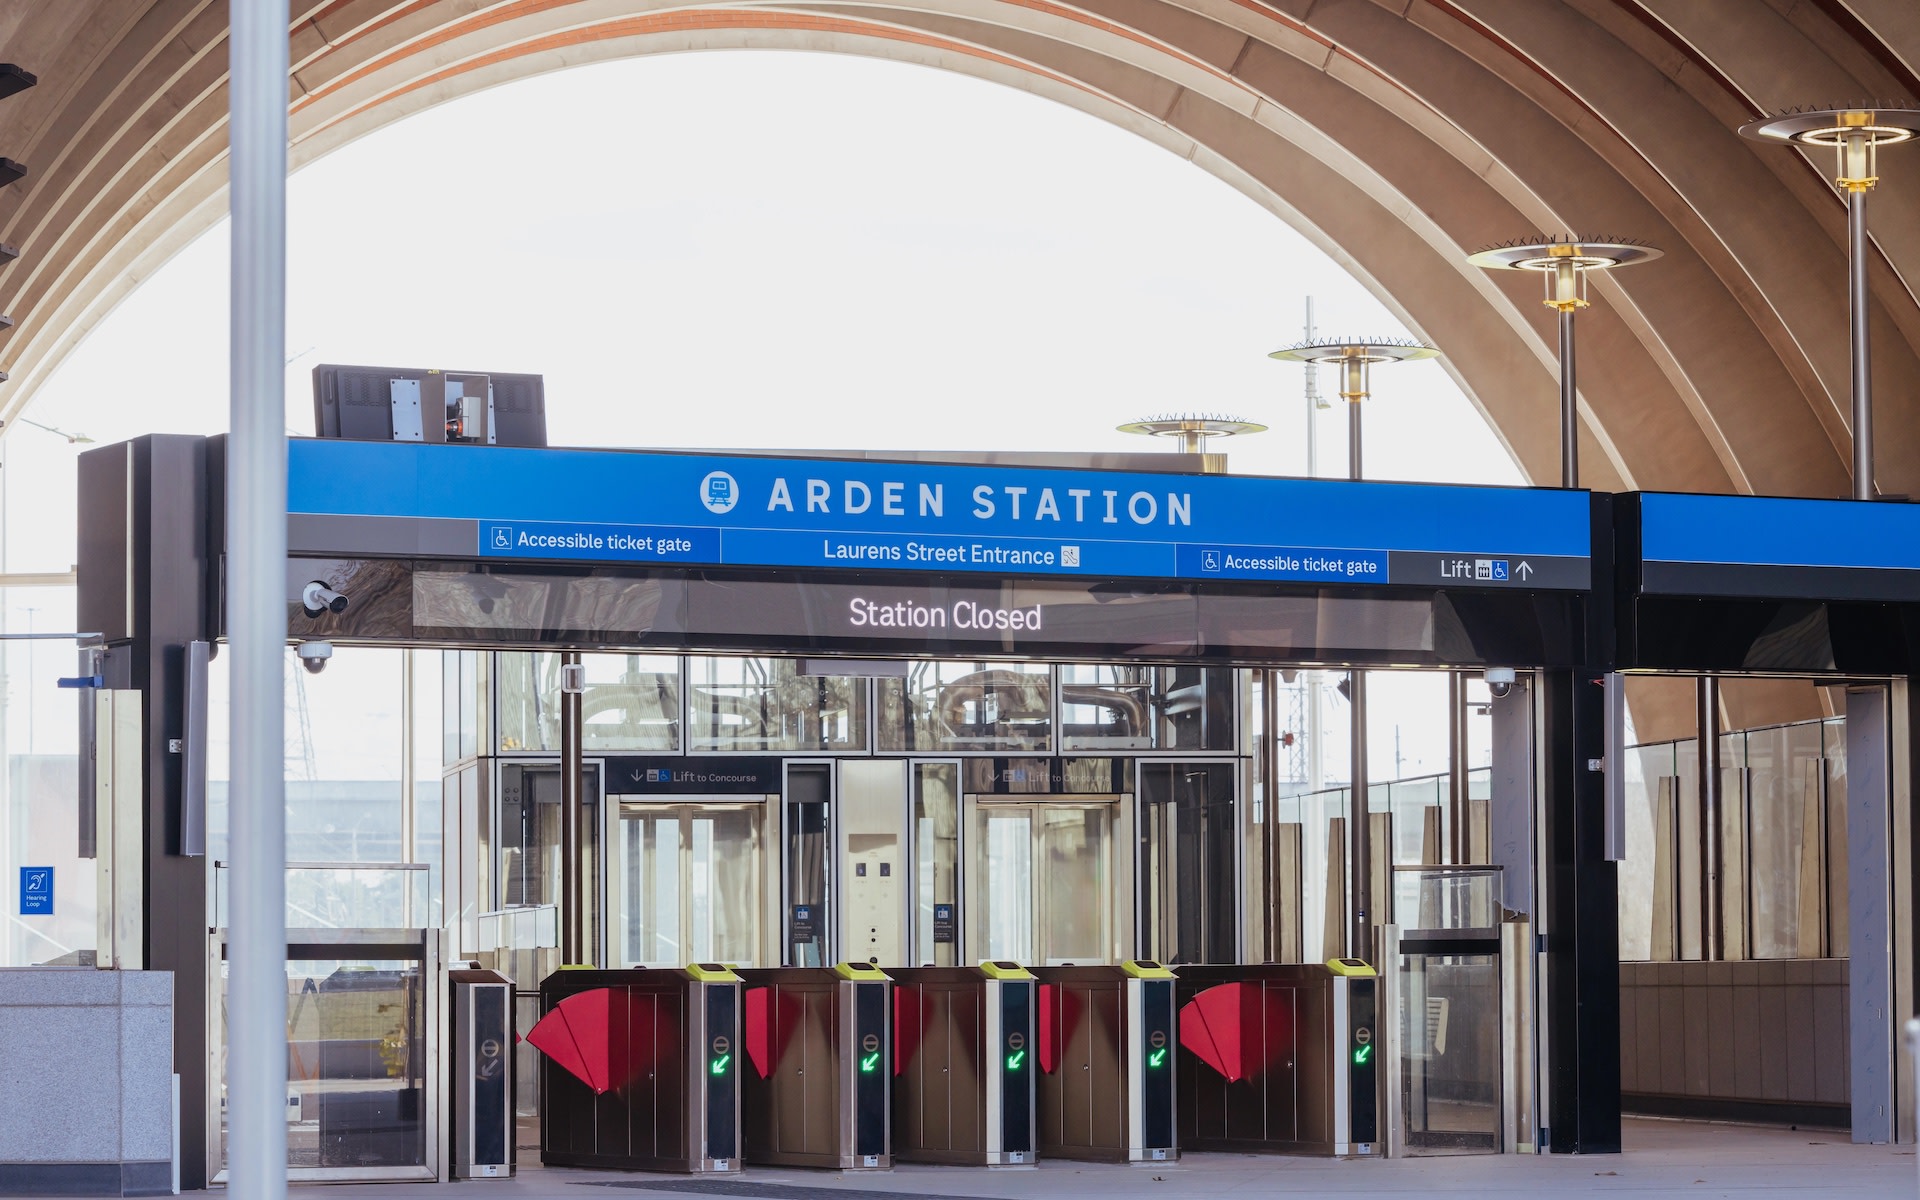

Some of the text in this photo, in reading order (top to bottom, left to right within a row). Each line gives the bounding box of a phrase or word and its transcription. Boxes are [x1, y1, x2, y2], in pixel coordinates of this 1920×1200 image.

[767, 478, 1192, 526] ARDEN STATION
[518, 531, 692, 554] Accessible ticket gate
[824, 540, 1054, 564] Laurens Street Entrance
[1225, 555, 1377, 576] Accessible ticket gate
[1441, 560, 1472, 578] Lift
[850, 598, 1042, 630] Station Closed
[674, 772, 756, 782] Lift to Concourse
[1030, 772, 1050, 782] Lift
